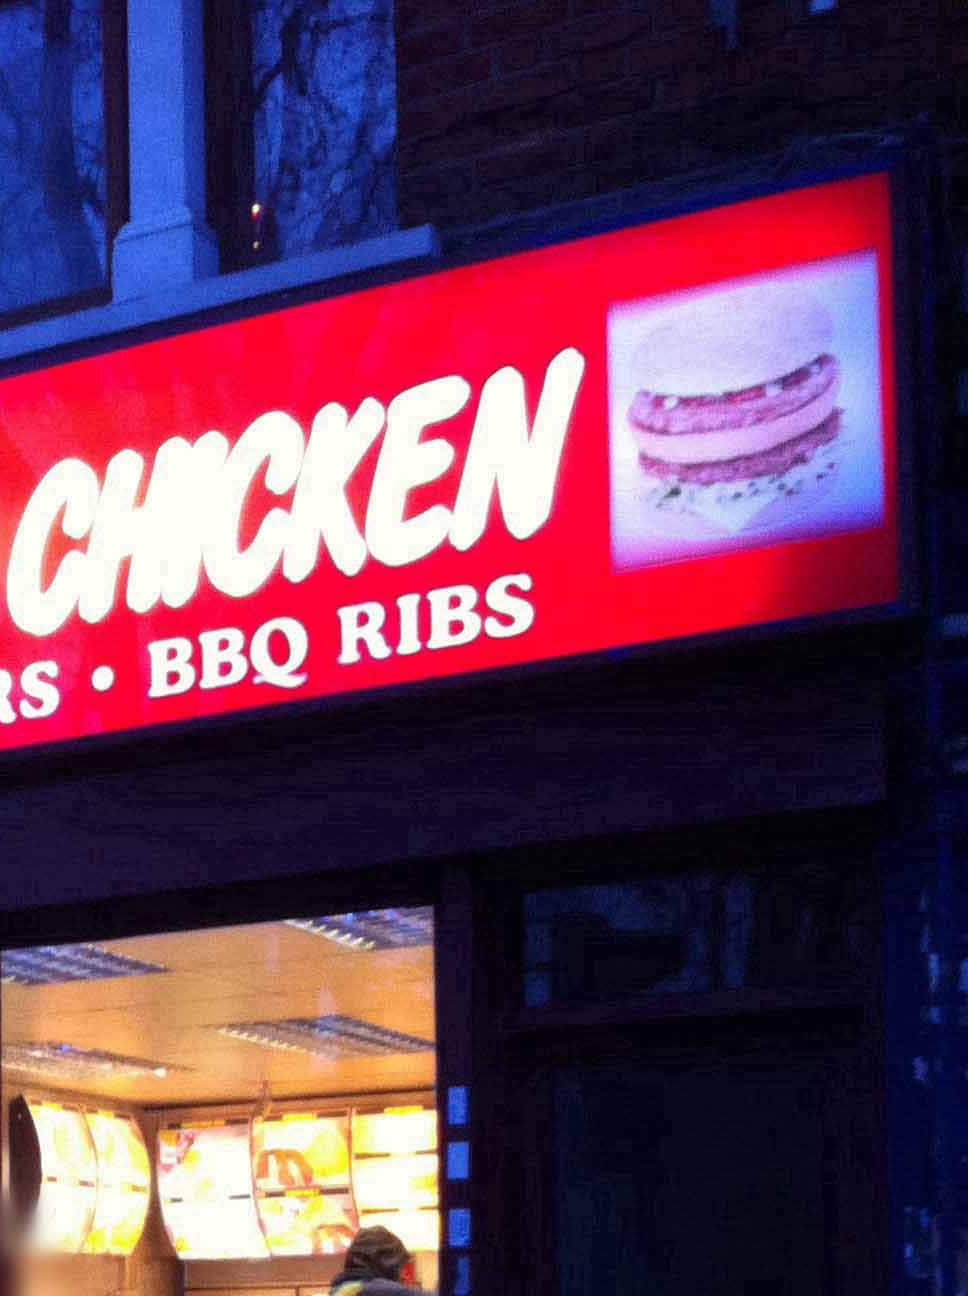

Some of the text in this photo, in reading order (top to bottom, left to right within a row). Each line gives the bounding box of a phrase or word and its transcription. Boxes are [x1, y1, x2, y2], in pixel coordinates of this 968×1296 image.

[6, 347, 585, 637] CHICKEN
[147, 617, 309, 698] BBQ
[337, 573, 535, 664] RIBS
